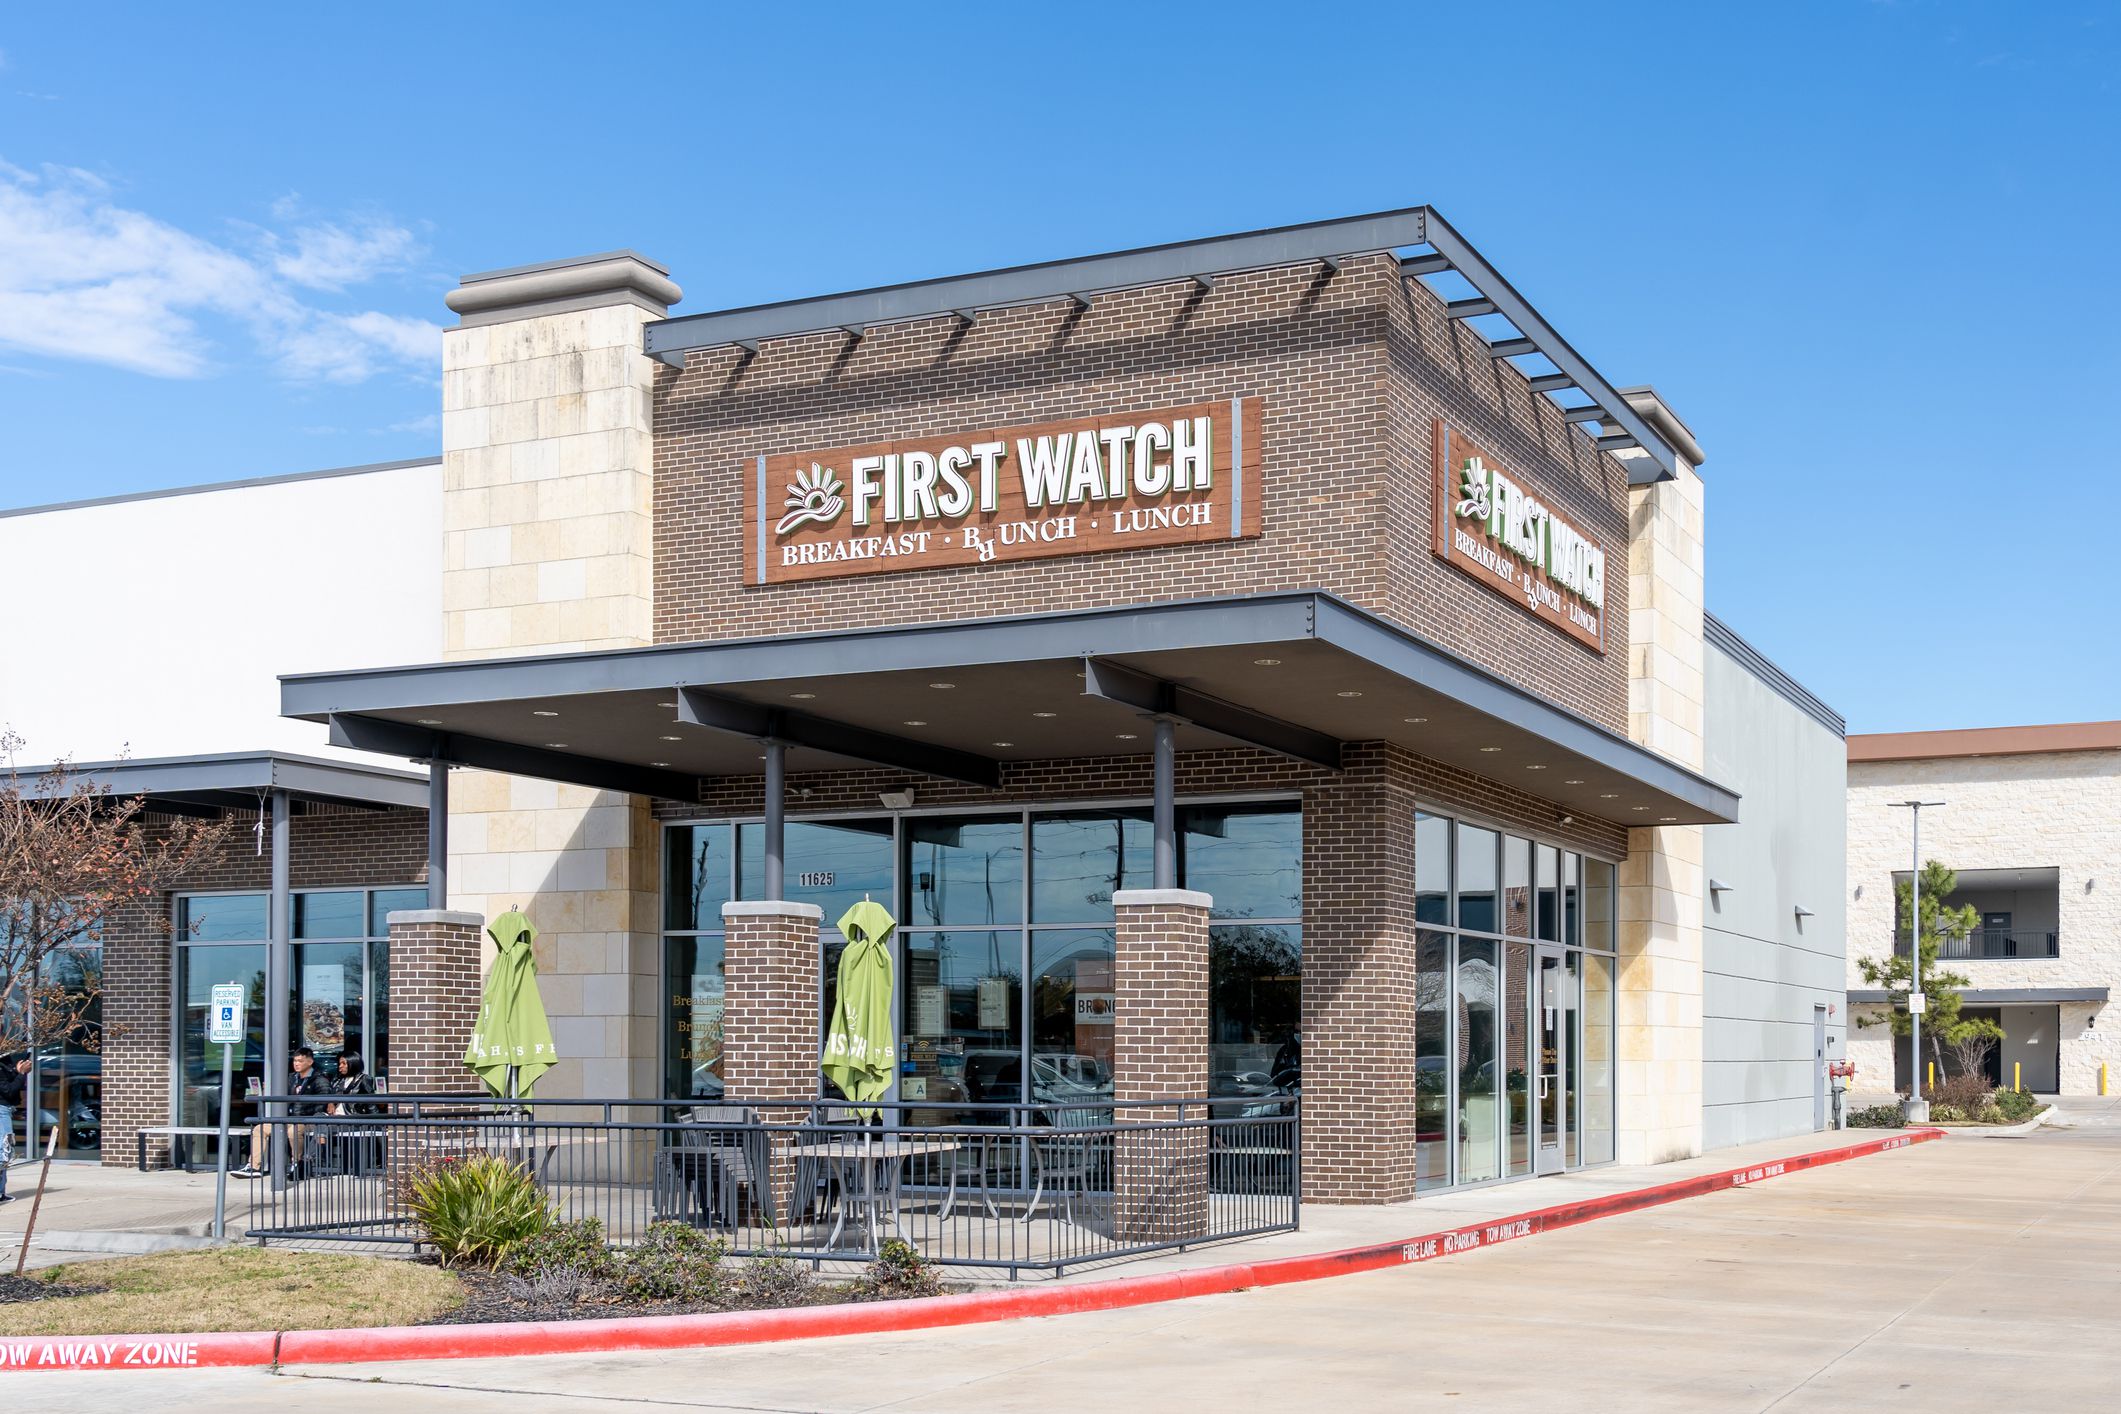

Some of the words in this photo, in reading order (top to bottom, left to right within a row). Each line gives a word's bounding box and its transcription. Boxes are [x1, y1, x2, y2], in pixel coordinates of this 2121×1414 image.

[852, 442, 1008, 526] FIRST
[1016, 416, 1213, 508] WATCH
[780, 531, 931, 566] BREAKFAST
[1113, 502, 1212, 534] LUNCH
[1487, 469, 1549, 569] FIRST
[1546, 512, 1605, 609] WATCH
[1454, 528, 1514, 584] BREAKFAST
[1569, 602, 1597, 636] LUNCH
[801, 872, 832, 886] 11625
[215, 990, 241, 998] RESERVED
[221, 1021, 232, 1029] VAN
[916, 1084, 925, 1094] A
[1403, 1244, 1419, 1261] FIRE
[1420, 1240, 1437, 1258] LANE
[1444, 1237, 1453, 1253] NO
[1454, 1230, 1480, 1251] PARKING
[1486, 1226, 1499, 1242] TOW
[1500, 1221, 1516, 1240] AWAY
[1516, 1219, 1531, 1236] ZONE
[38, 1343, 118, 1365] AWAY
[123, 1342, 198, 1364] ZONE
